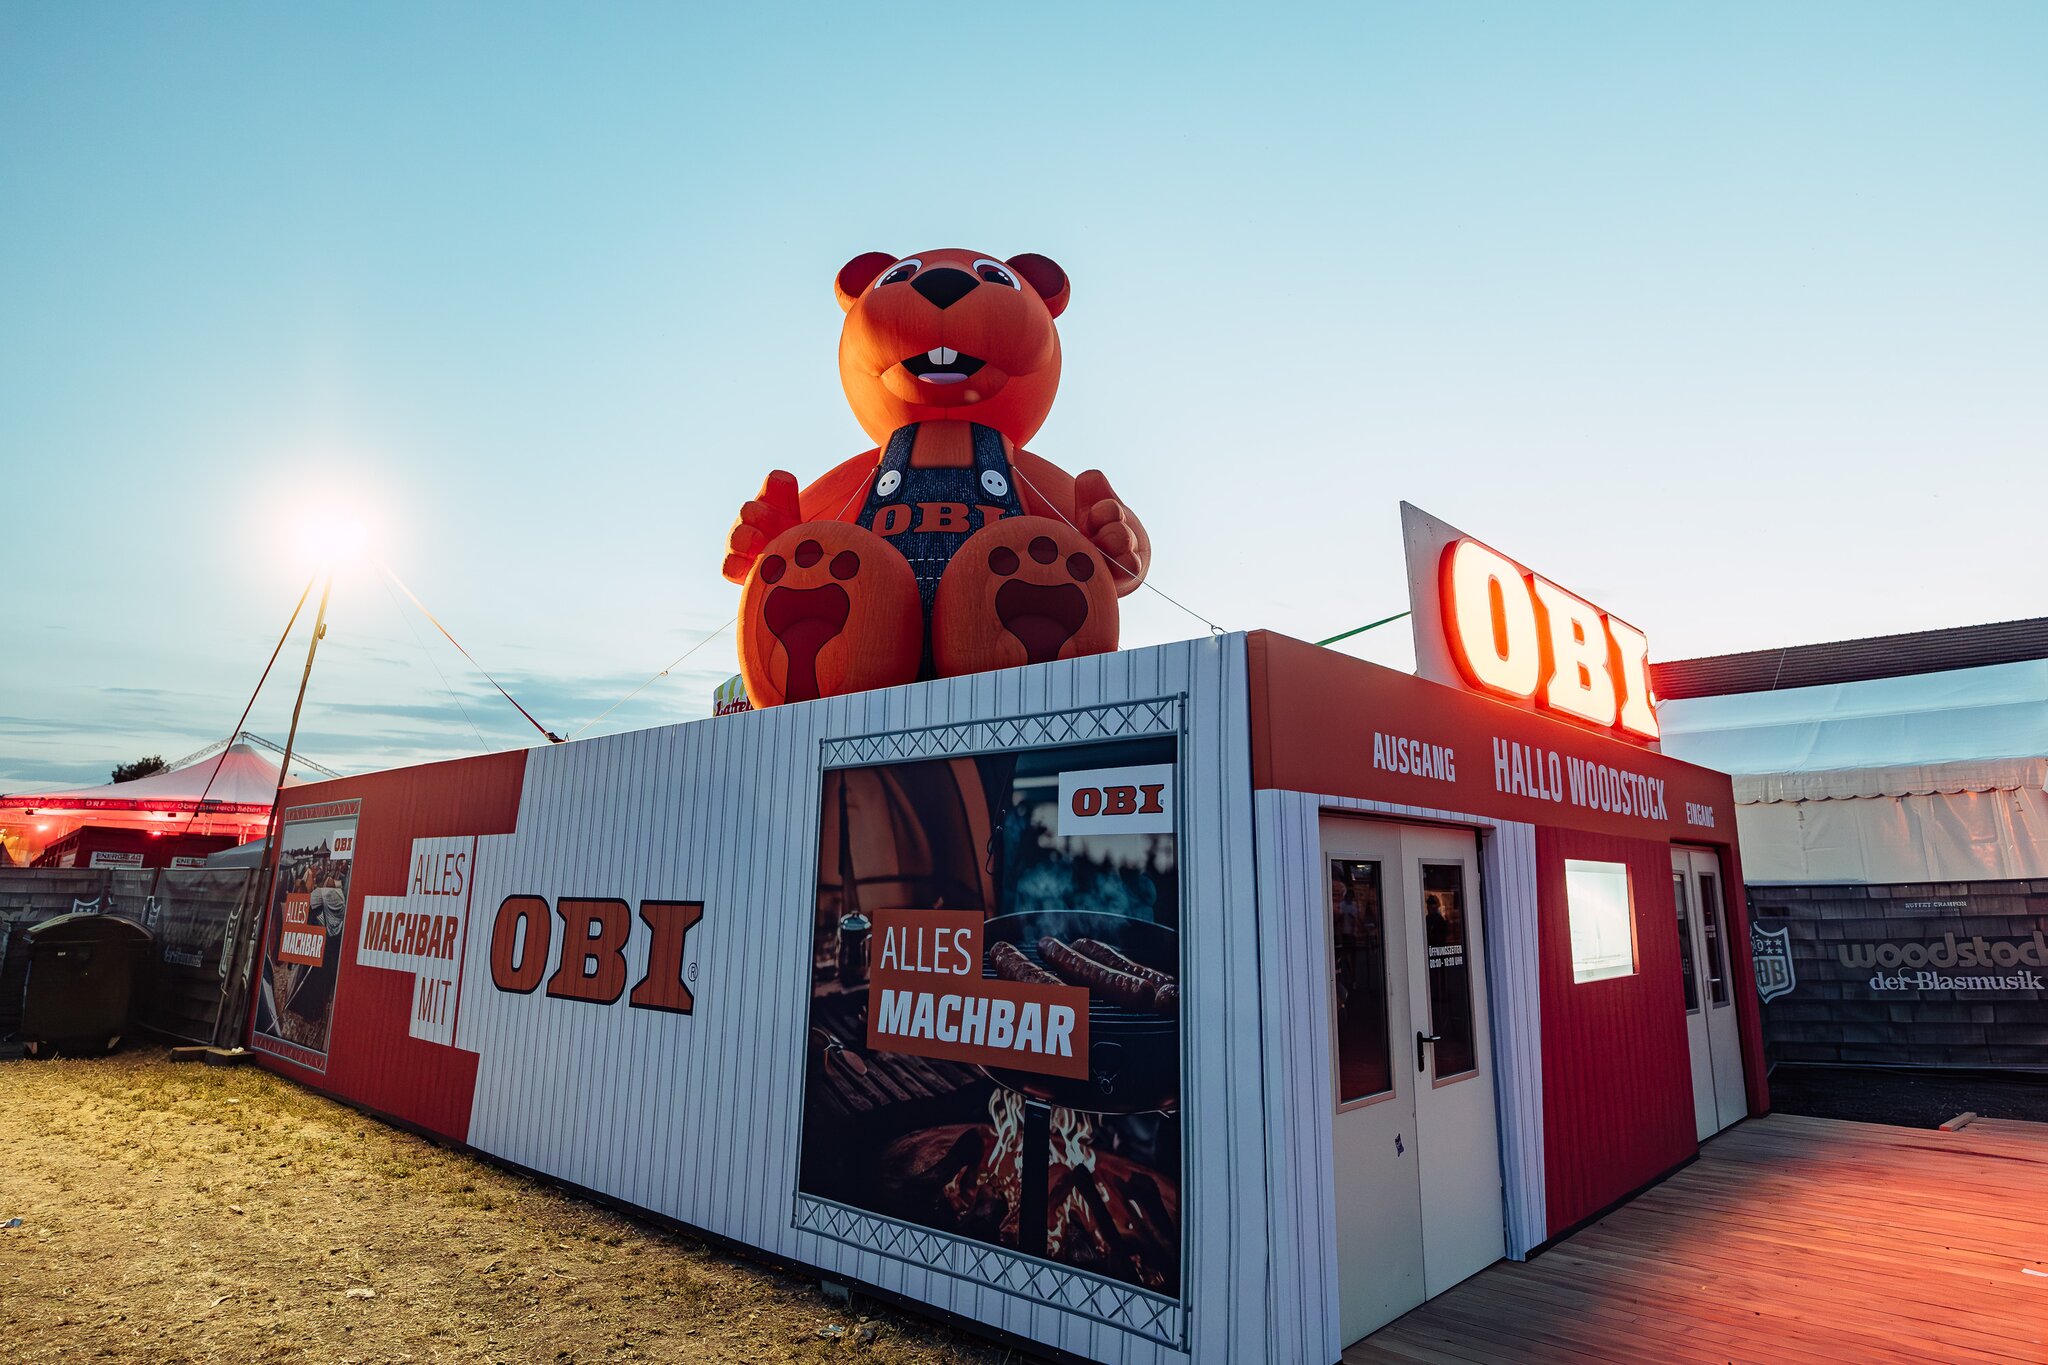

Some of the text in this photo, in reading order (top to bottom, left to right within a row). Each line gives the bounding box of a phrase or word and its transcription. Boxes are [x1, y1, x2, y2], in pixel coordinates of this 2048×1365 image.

[1438, 537, 1660, 740] OBI
[1373, 732, 1456, 782] AUSGANG
[1493, 736, 1668, 821] HALLO WOODSTOCK
[1072, 784, 1165, 817] OBI
[1686, 802, 1715, 828] EINGANG
[334, 838, 353, 851] OBI
[412, 853, 466, 896] ALLES
[286, 901, 308, 924] ALLES
[363, 911, 459, 960] MACHBAR
[281, 931, 324, 958] MACHBAR
[490, 894, 705, 1016] OBI
[880, 926, 972, 975] ALLES
[418, 977, 452, 1025] MIT
[1869, 967, 2045, 991] der Blasmusik
[877, 989, 1076, 1058] MACHBAR
